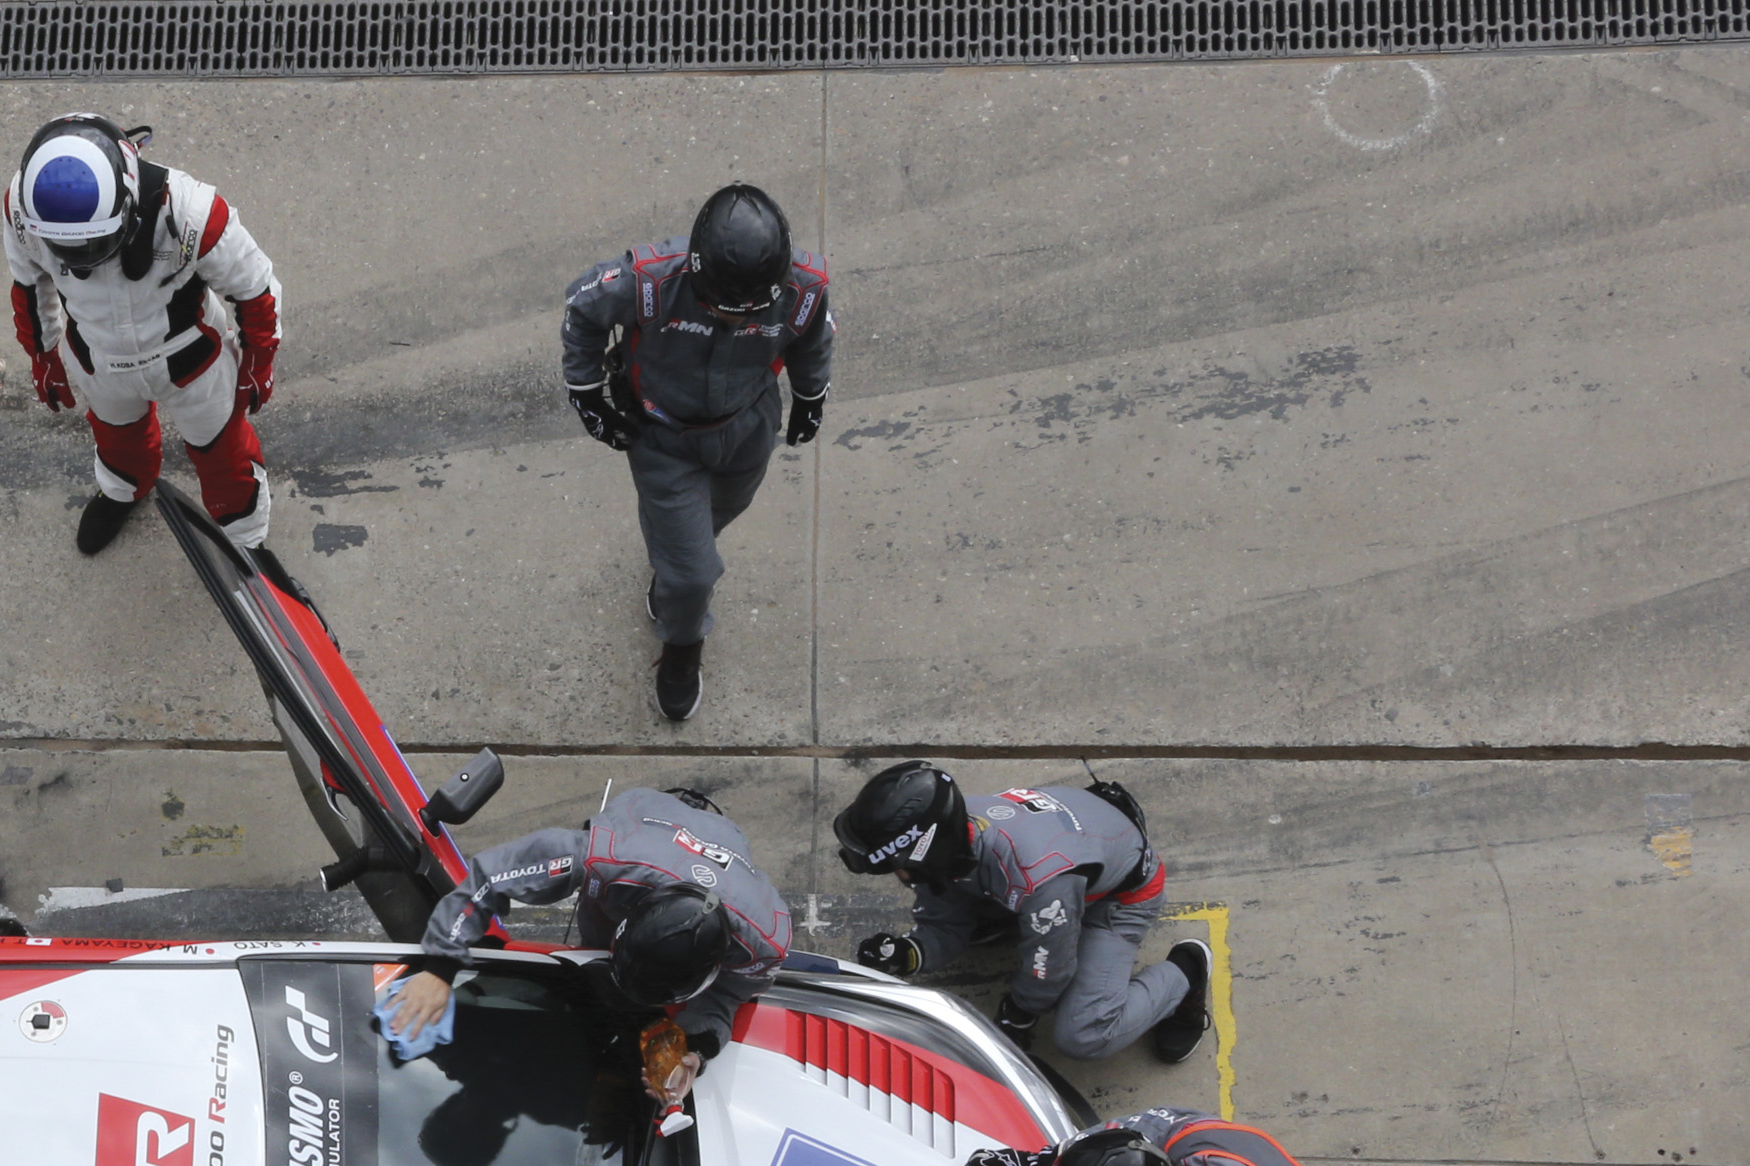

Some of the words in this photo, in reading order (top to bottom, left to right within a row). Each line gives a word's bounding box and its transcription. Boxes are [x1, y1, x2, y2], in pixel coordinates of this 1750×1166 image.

[677, 831, 731, 865] GR
[868, 824, 924, 865] uvex
[490, 863, 547, 884] TOYOTA
[549, 857, 573, 872] GR
[63, 939, 171, 952] KAGEYAMA
[207, 1023, 235, 1124] Racing
